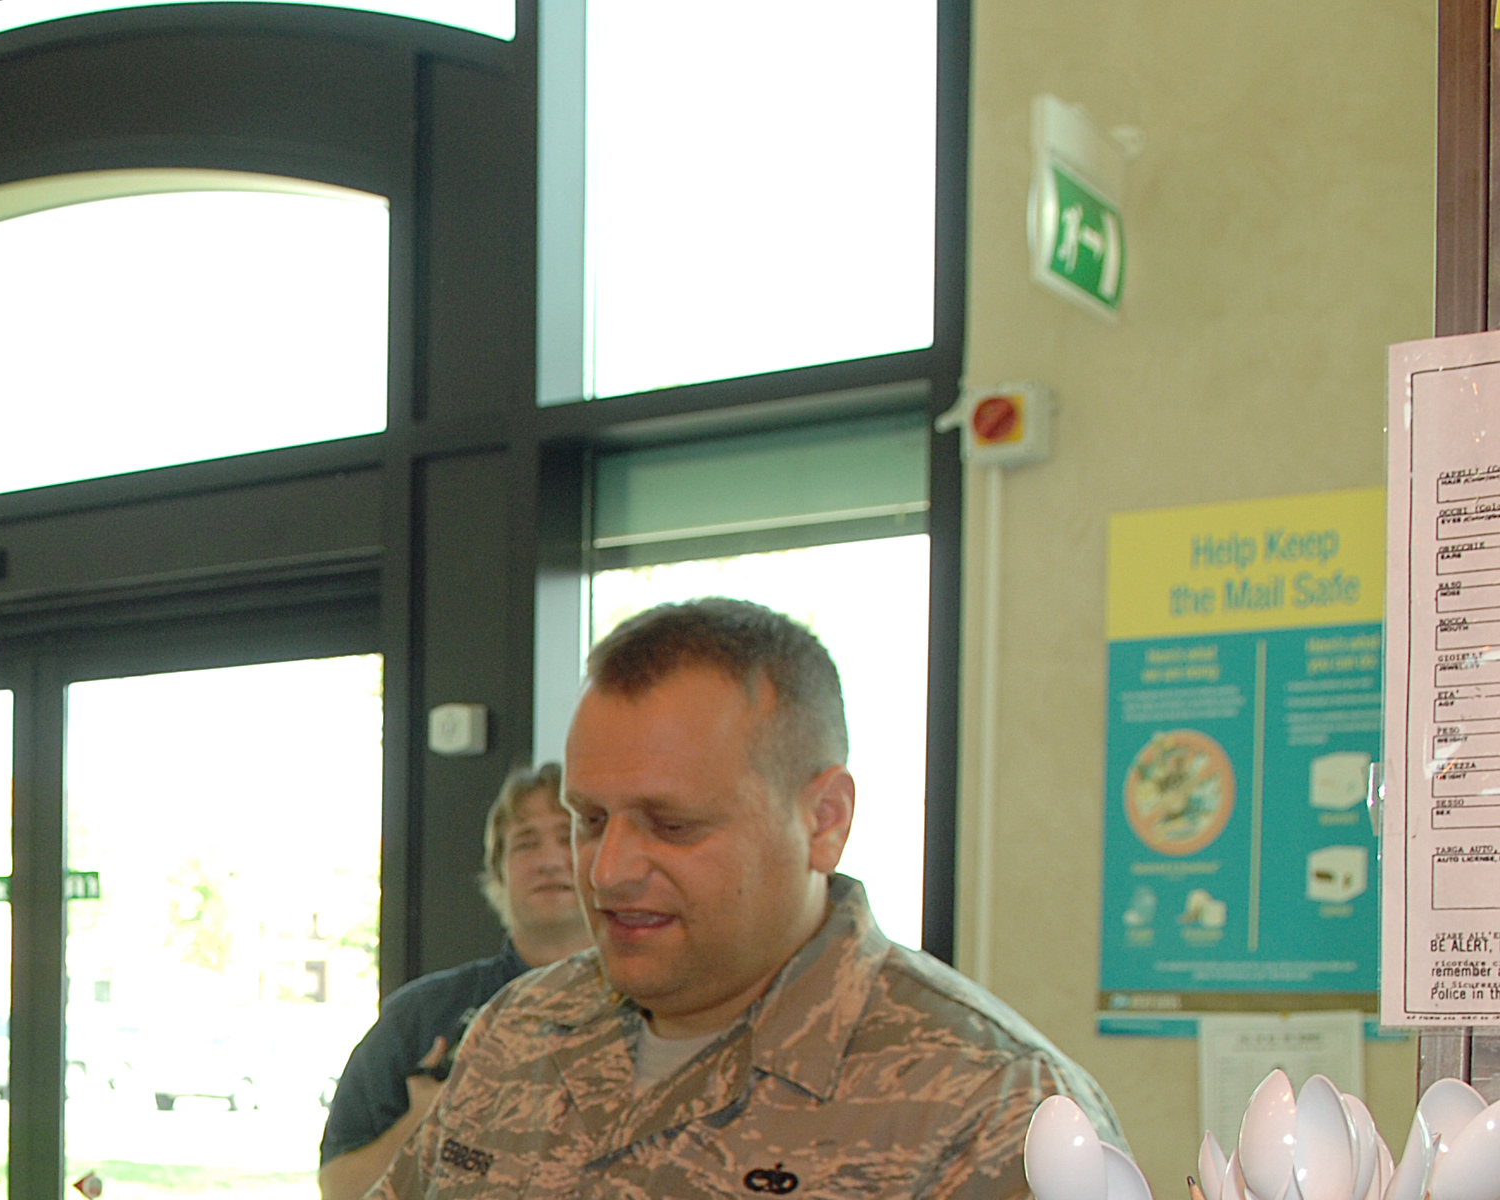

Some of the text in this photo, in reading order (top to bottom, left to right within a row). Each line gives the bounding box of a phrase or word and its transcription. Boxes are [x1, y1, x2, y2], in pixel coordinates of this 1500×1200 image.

[1439, 507, 1467, 517] OCCHI
[1190, 527, 1340, 570] Help Keep
[1439, 581, 1462, 589] NASO
[1169, 569, 1360, 618] the Mail Safe
[1439, 617, 1468, 626] BOCCA
[1437, 727, 1460, 735] PESO
[1436, 799, 1464, 807] SESSO
[1435, 846, 1464, 855] TARGA
[1430, 940, 1492, 953] BE ALERT,
[1431, 967, 1491, 977] remember
[1431, 988, 1466, 999] Police
[1472, 989, 1484, 999] in
